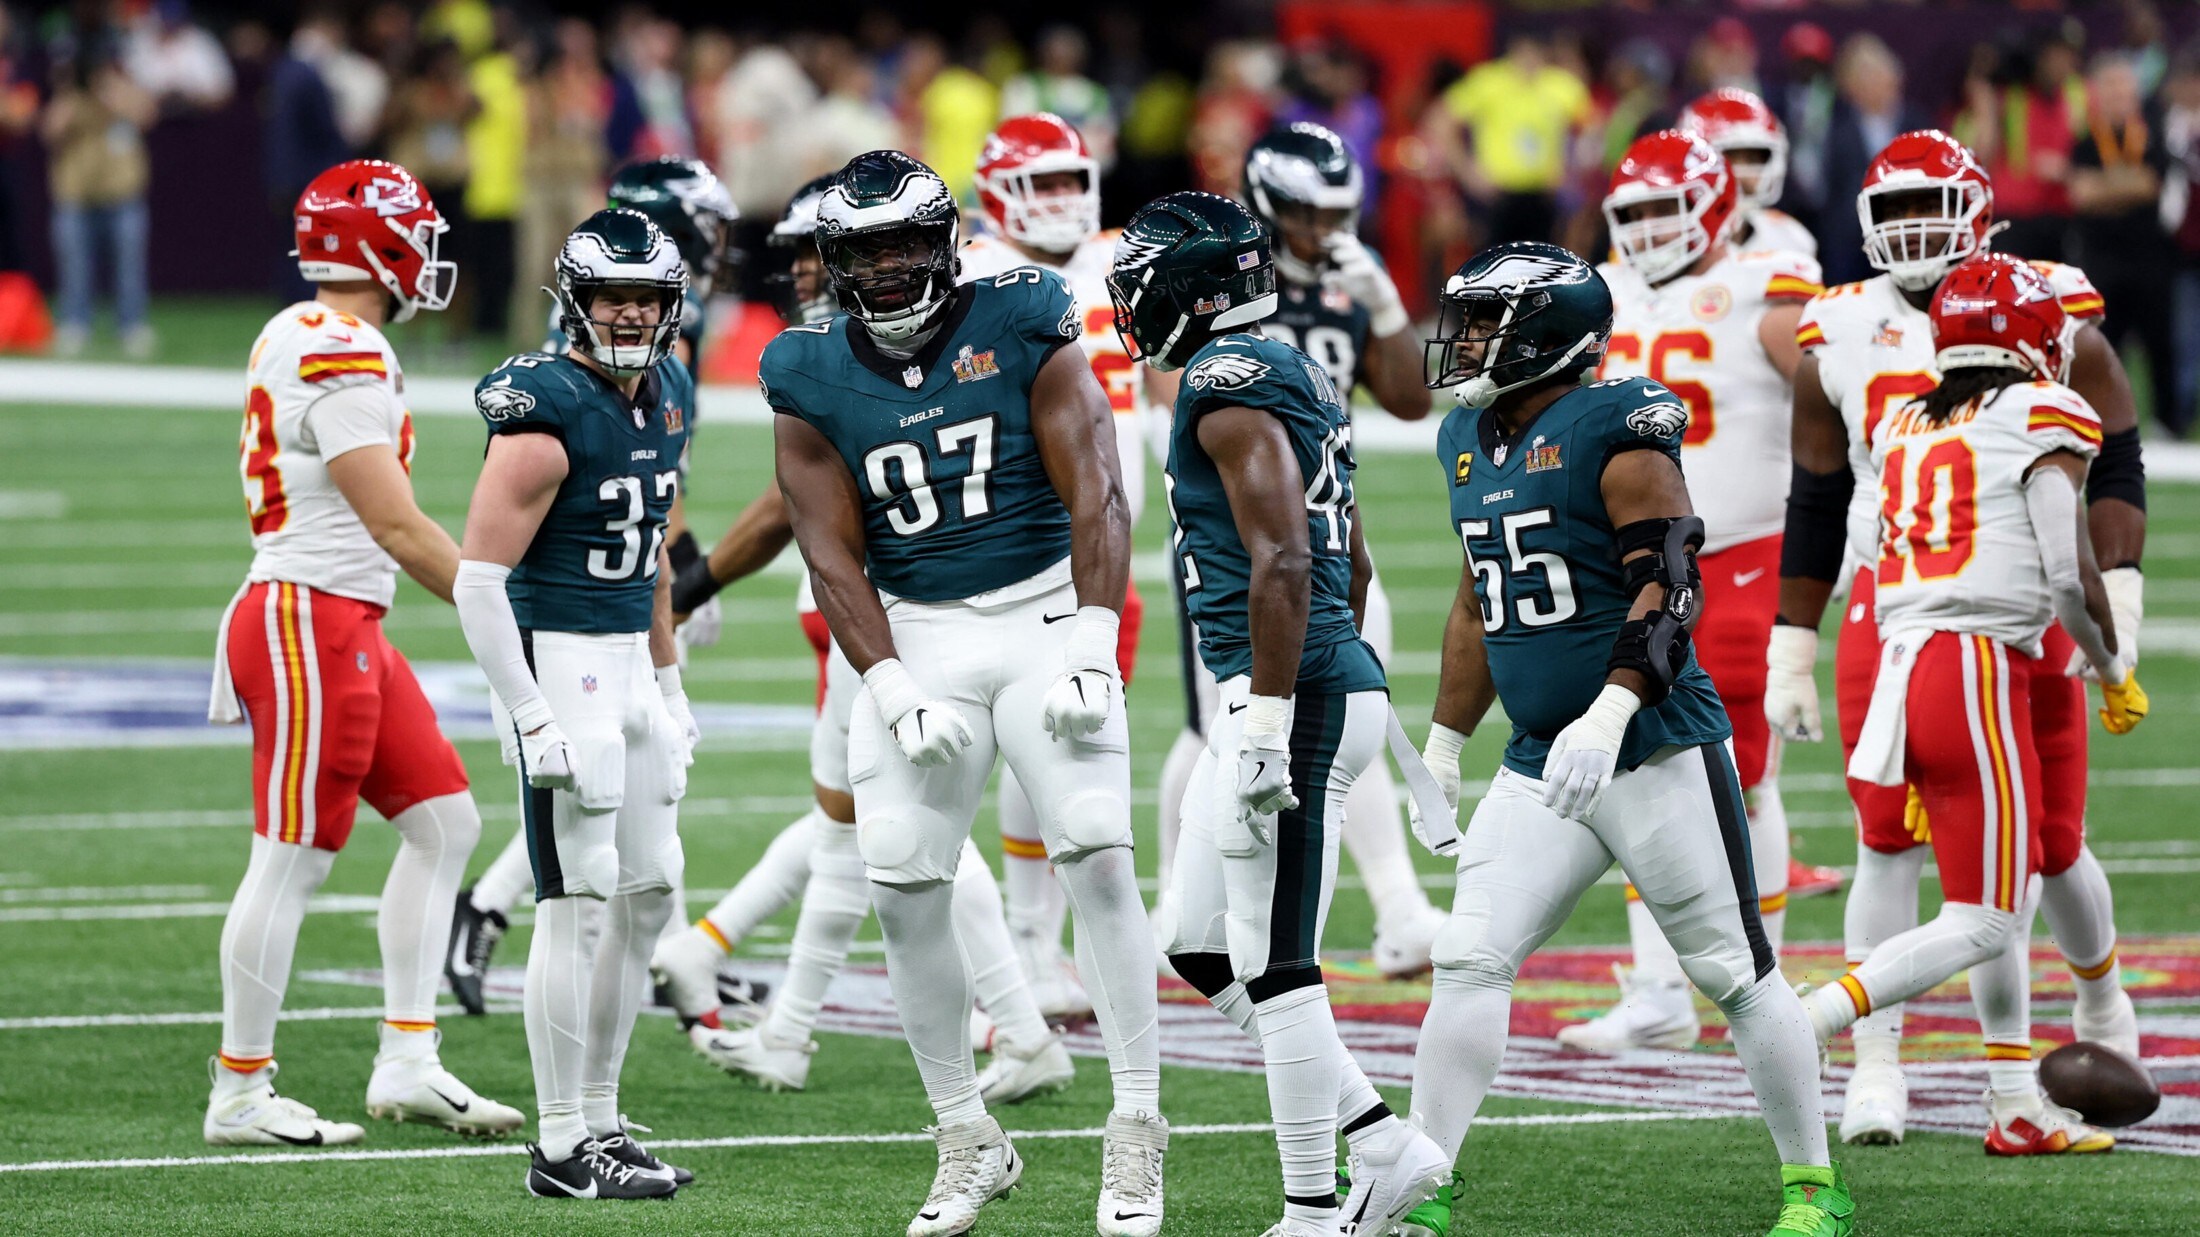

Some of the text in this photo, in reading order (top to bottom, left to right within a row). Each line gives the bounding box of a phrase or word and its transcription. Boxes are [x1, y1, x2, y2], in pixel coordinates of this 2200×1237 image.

[1245, 268, 1273, 298] 42
[900, 406, 944, 428] EAGLES
[241, 385, 288, 536] 3
[631, 449, 658, 461] EAGLES
[864, 415, 994, 535] 97
[1458, 453, 1472, 477] C
[586, 471, 678, 580] 32
[1482, 489, 1514, 505] EAGLES
[1878, 436, 1977, 587] 10
[1460, 509, 1577, 633] 55
